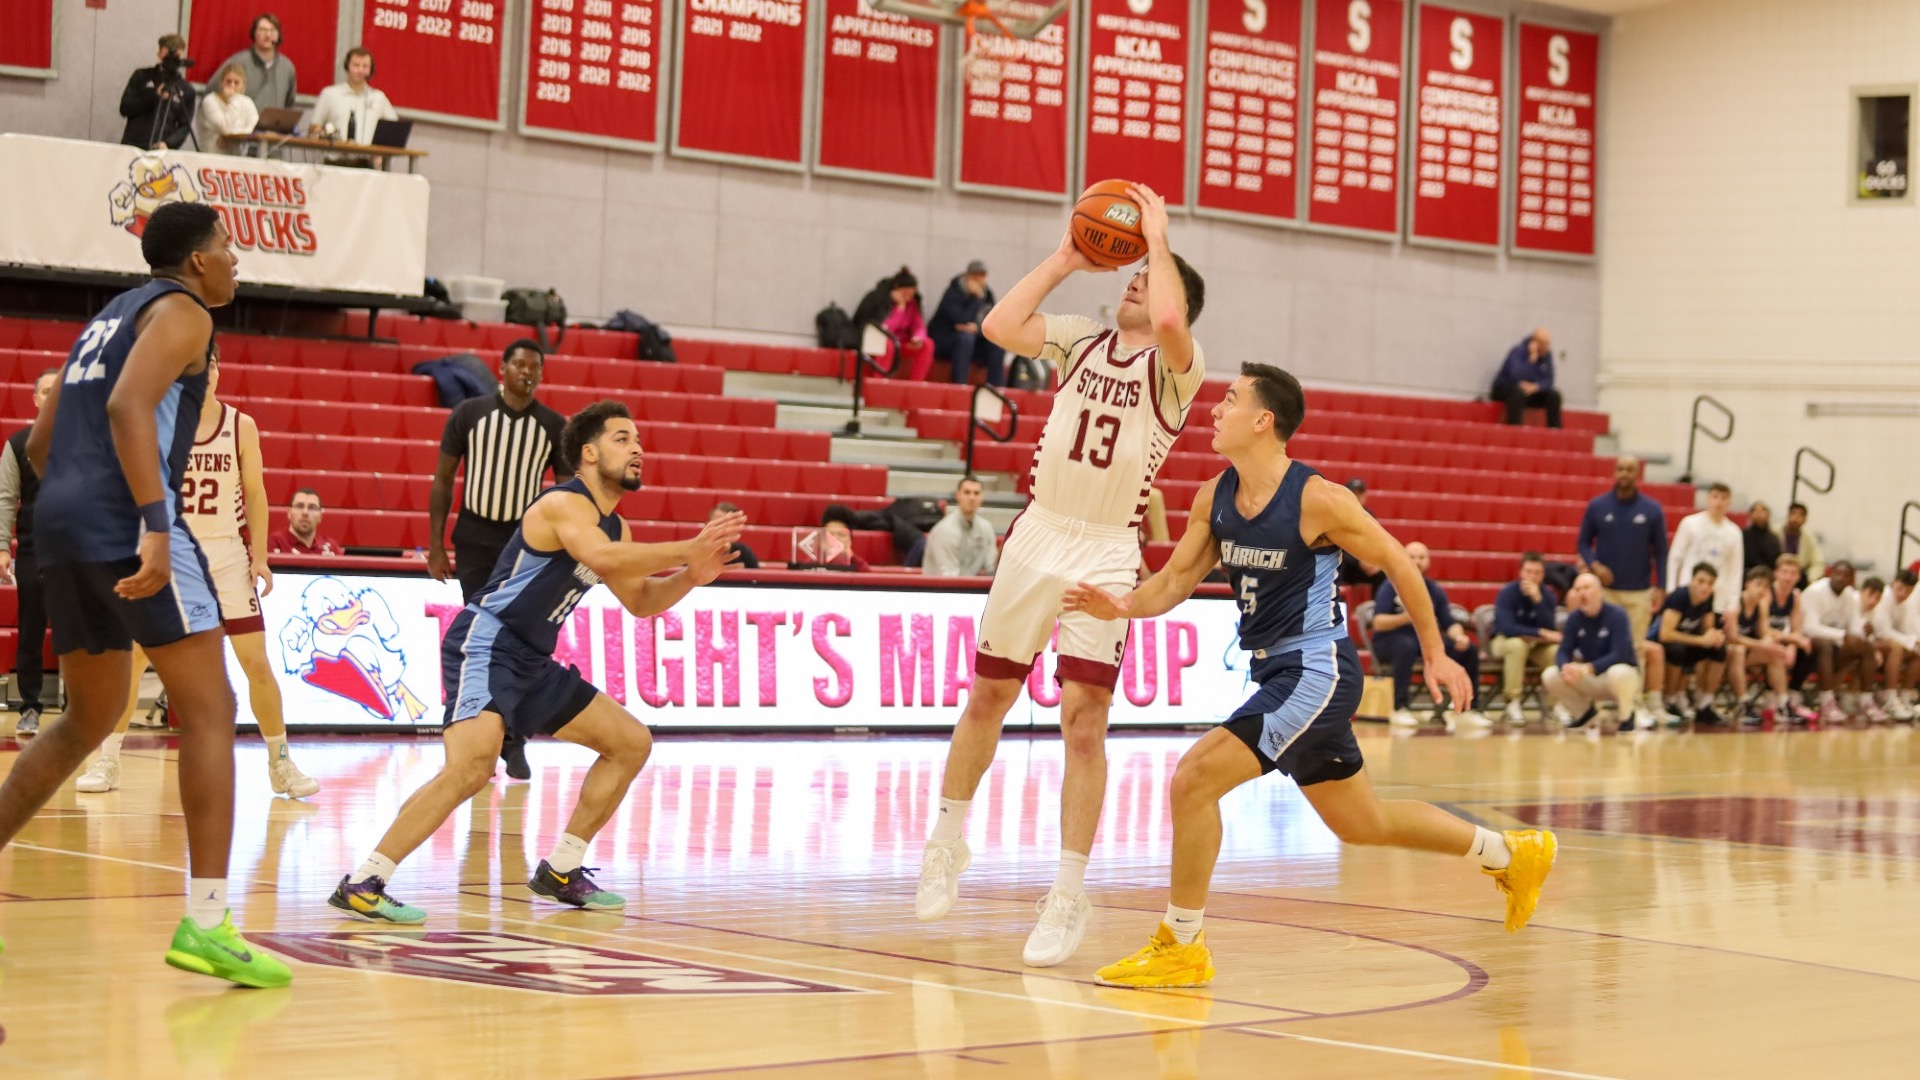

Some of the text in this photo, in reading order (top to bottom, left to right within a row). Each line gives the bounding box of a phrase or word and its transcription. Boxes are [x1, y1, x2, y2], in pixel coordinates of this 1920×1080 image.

[373, 7, 494, 44] 2019 2022 2023
[460, 0, 494, 21] 2018
[583, 0, 613, 18] 2011
[621, 3, 653, 25] 2012
[1347, 0, 1371, 53] S
[541, 13, 651, 48] 2013 2014 2015
[691, 15, 763, 42] 2021 2022
[831, 14, 934, 47] APPEARANCES
[1449, 17, 1474, 71] S
[539, 35, 651, 70] 2016 2017 2018
[1115, 35, 1162, 61] NCAA
[1208, 48, 1296, 79] CONFERENCE
[1548, 35, 1570, 86] S
[538, 58, 652, 93] 2019 2021 2022
[1093, 54, 1184, 83] APPEARANCES
[1208, 67, 1296, 99] CHAMPIONS
[1336, 70, 1378, 96] NCAA
[536, 81, 571, 103] 2023
[1316, 88, 1397, 117] APPEARANCES
[1538, 103, 1576, 126] NCAA
[198, 168, 307, 209] STEVENS
[1085, 227, 1141, 255] THE ROCK
[1068, 408, 1121, 470] 13
[186, 453, 232, 472] EVENS
[182, 477, 219, 515] 22
[1220, 539, 1288, 571] BARUCH
[249, 598, 258, 613] S
[1240, 574, 1259, 616] 5
[424, 603, 854, 708] TNIGHT'S
[1113, 640, 1123, 662] S
